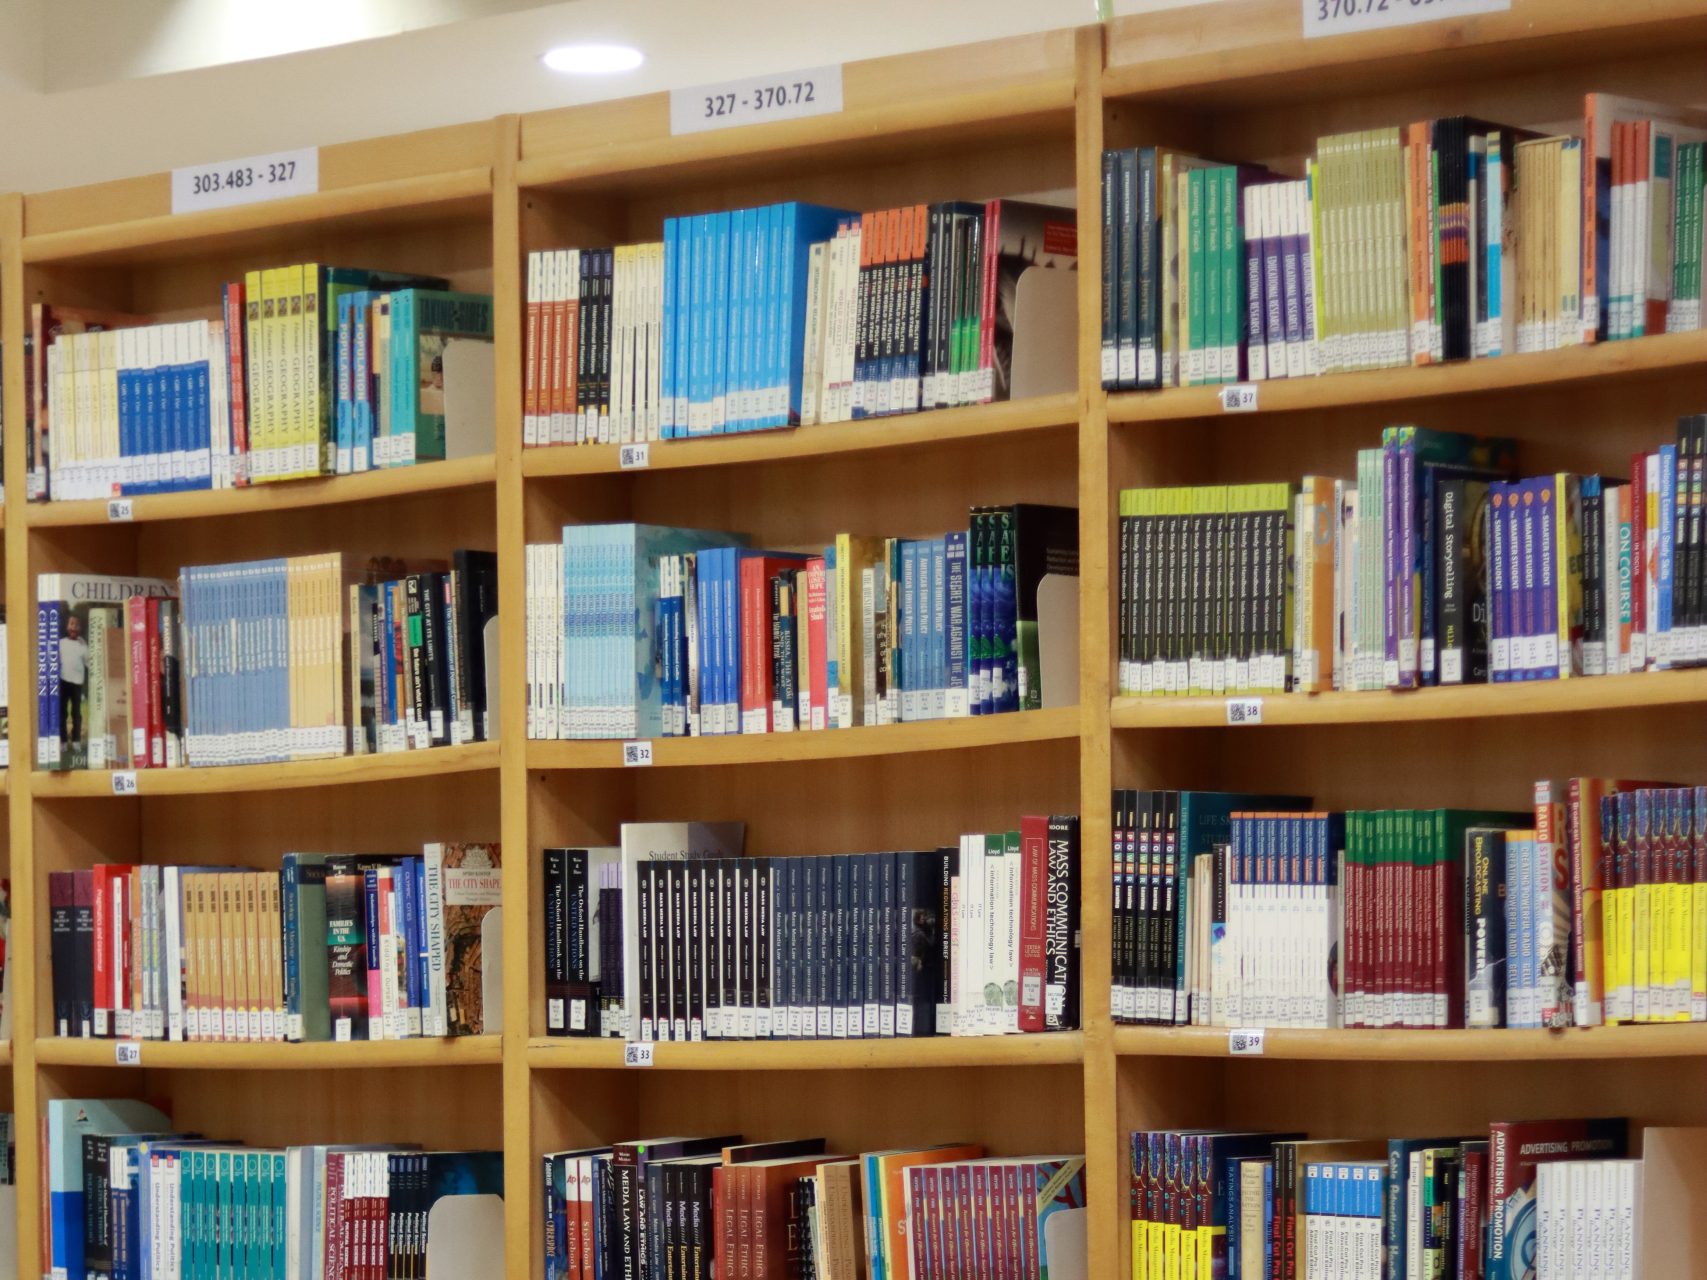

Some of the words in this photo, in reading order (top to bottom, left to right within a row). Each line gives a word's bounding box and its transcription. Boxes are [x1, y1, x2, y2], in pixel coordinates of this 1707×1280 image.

[704, 92, 736, 118] 327
[754, 81, 815, 111] 370.72
[193, 168, 254, 195] 303.483
[268, 161, 296, 184] 327
[1250, 301, 1259, 335] RESEARCH
[357, 323, 365, 400] POPULATION
[307, 355, 315, 430] GEOGRAPHY
[1242, 393, 1253, 403] 37
[635, 451, 645, 461] 31
[121, 506, 129, 515] 25
[1445, 492, 1454, 520] Digital
[1620, 527, 1630, 551] ON
[951, 562, 961, 573] THE
[1444, 526, 1454, 599] Storytelling
[951, 575, 962, 603] SECRET
[1620, 557, 1630, 622] COURSE
[425, 618, 432, 626] AT
[50, 609, 58, 697] CHILDREN
[951, 625, 962, 658] AGAINST
[1247, 706, 1257, 716] 38
[640, 750, 649, 758] 32
[126, 779, 135, 788] 26
[1538, 805, 1548, 840] RADIO
[1008, 845, 1019, 853] Lloyd
[1047, 840, 1057, 871] LAW
[1057, 840, 1068, 878] MASS
[428, 864, 438, 890] THE
[1475, 837, 1483, 915] BROADCASTING
[1540, 845, 1548, 892] STATION
[449, 879, 462, 889] THE
[463, 878, 478, 888] CITY
[479, 878, 501, 889] SHAPE
[1046, 872, 1056, 903] AND
[430, 893, 439, 919] CITY
[330, 920, 353, 928] FAMILIES
[333, 927, 340, 935] IN
[339, 927, 349, 935] THE
[1046, 907, 1055, 955] ETHICS
[431, 924, 441, 971] SHAPED
[130, 1050, 137, 1059] 27
[640, 1050, 650, 1059] 33
[1248, 1036, 1259, 1047] 39
[1520, 1142, 1568, 1155] ADVERTISING
[1390, 1150, 1400, 1180] Cable
[726, 1209, 734, 1239] LEGAL
[1273, 1216, 1281, 1237] Final
[1273, 1259, 1281, 1276] Pro
